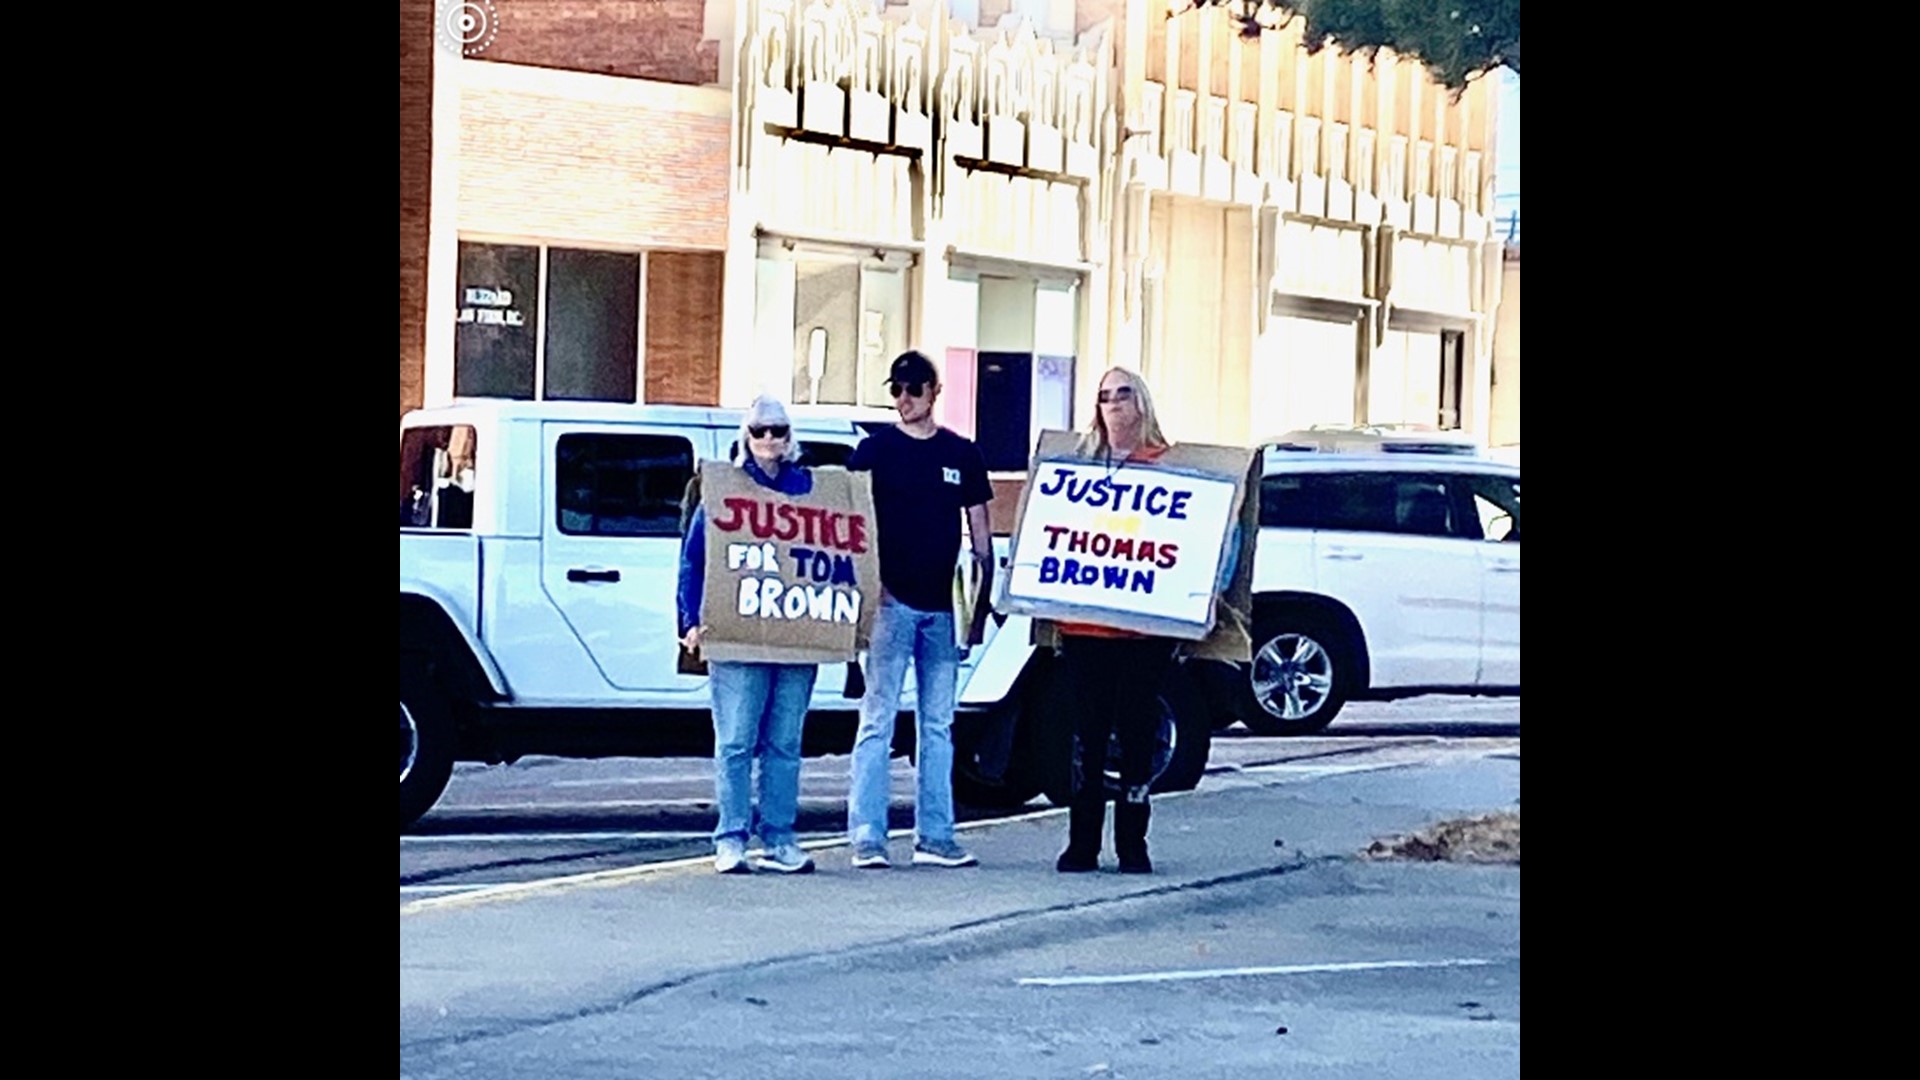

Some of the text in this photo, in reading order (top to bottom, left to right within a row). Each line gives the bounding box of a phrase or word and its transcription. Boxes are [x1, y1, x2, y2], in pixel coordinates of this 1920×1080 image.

[1040, 468, 1192, 520] JUSTICE
[713, 498, 867, 554] JUSTICE
[1044, 525, 1179, 569] THOMAS
[727, 542, 857, 586] FOR TOM
[1038, 557, 1155, 594] BROWN
[738, 577, 861, 624] BROWN
